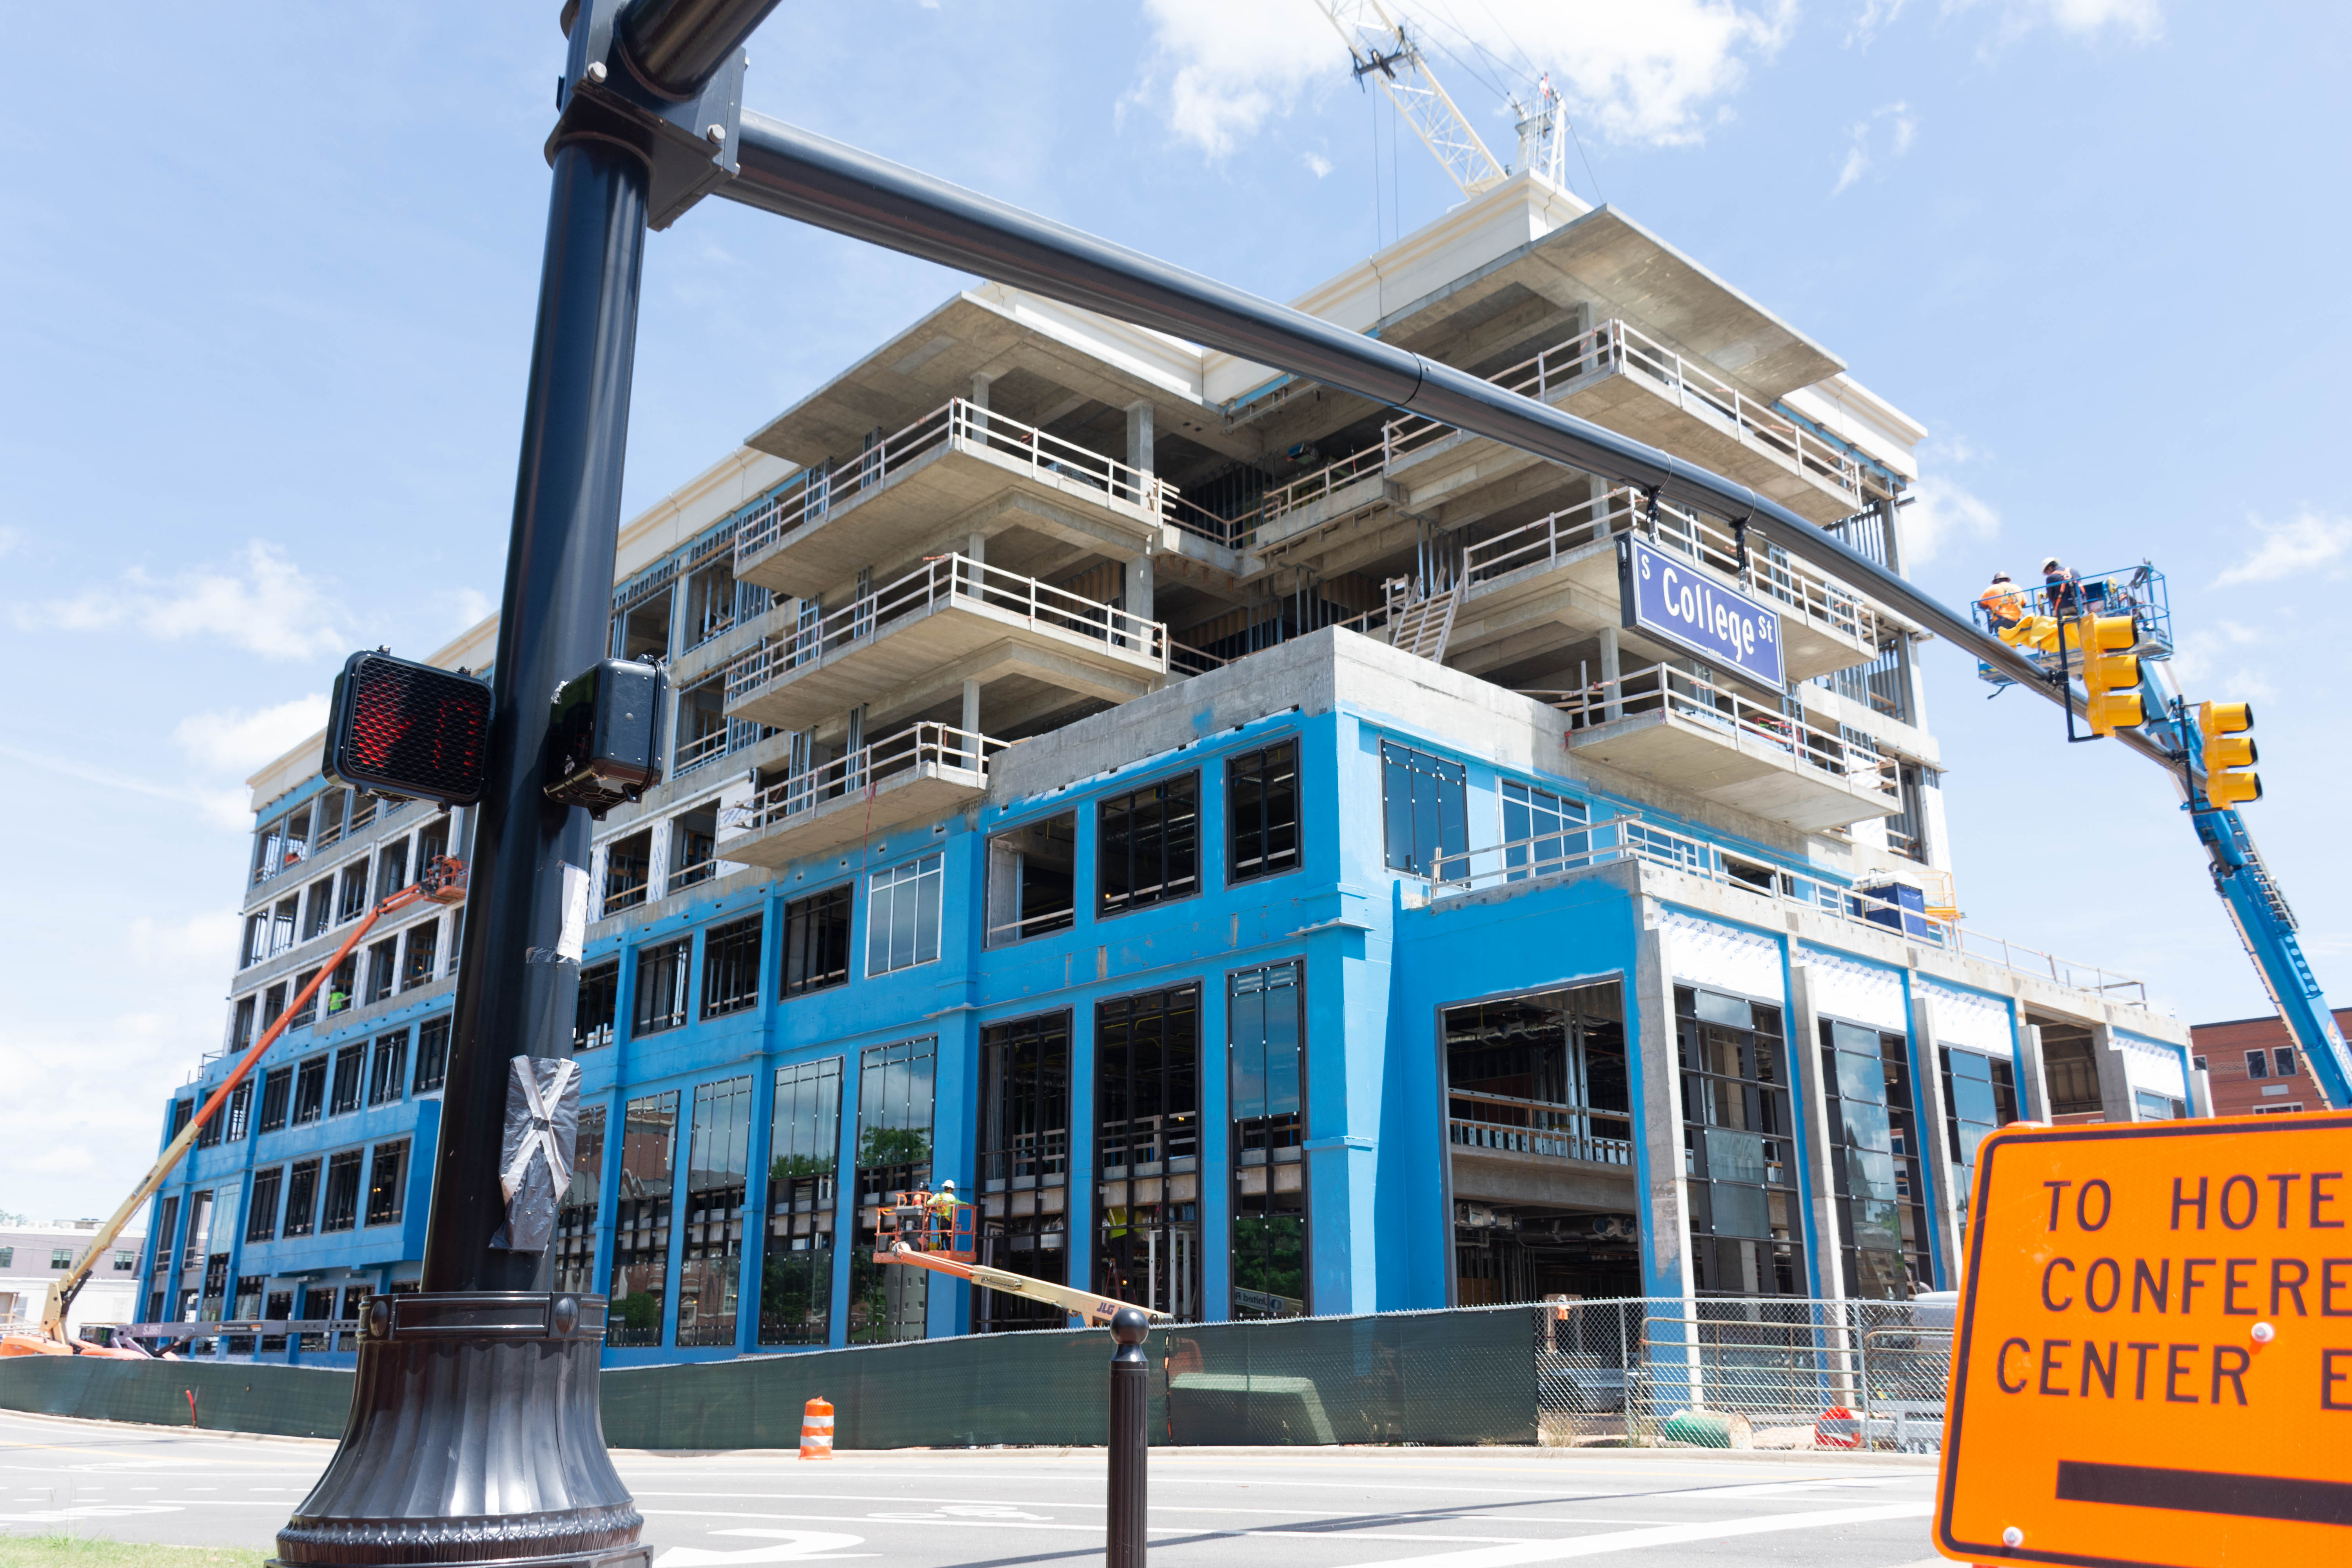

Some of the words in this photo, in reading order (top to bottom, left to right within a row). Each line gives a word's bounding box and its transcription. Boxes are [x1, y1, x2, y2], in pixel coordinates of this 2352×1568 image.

[1641, 554, 1651, 580] S
[1662, 567, 1755, 663] College
[1758, 615, 1773, 643] St
[2043, 1178, 2112, 1232] TO
[2170, 1172, 2345, 1230] HOTE
[1096, 1301, 1115, 1316] JLG
[2041, 1256, 2352, 1318] CONFERE
[1996, 1337, 2251, 1406] CENTER
